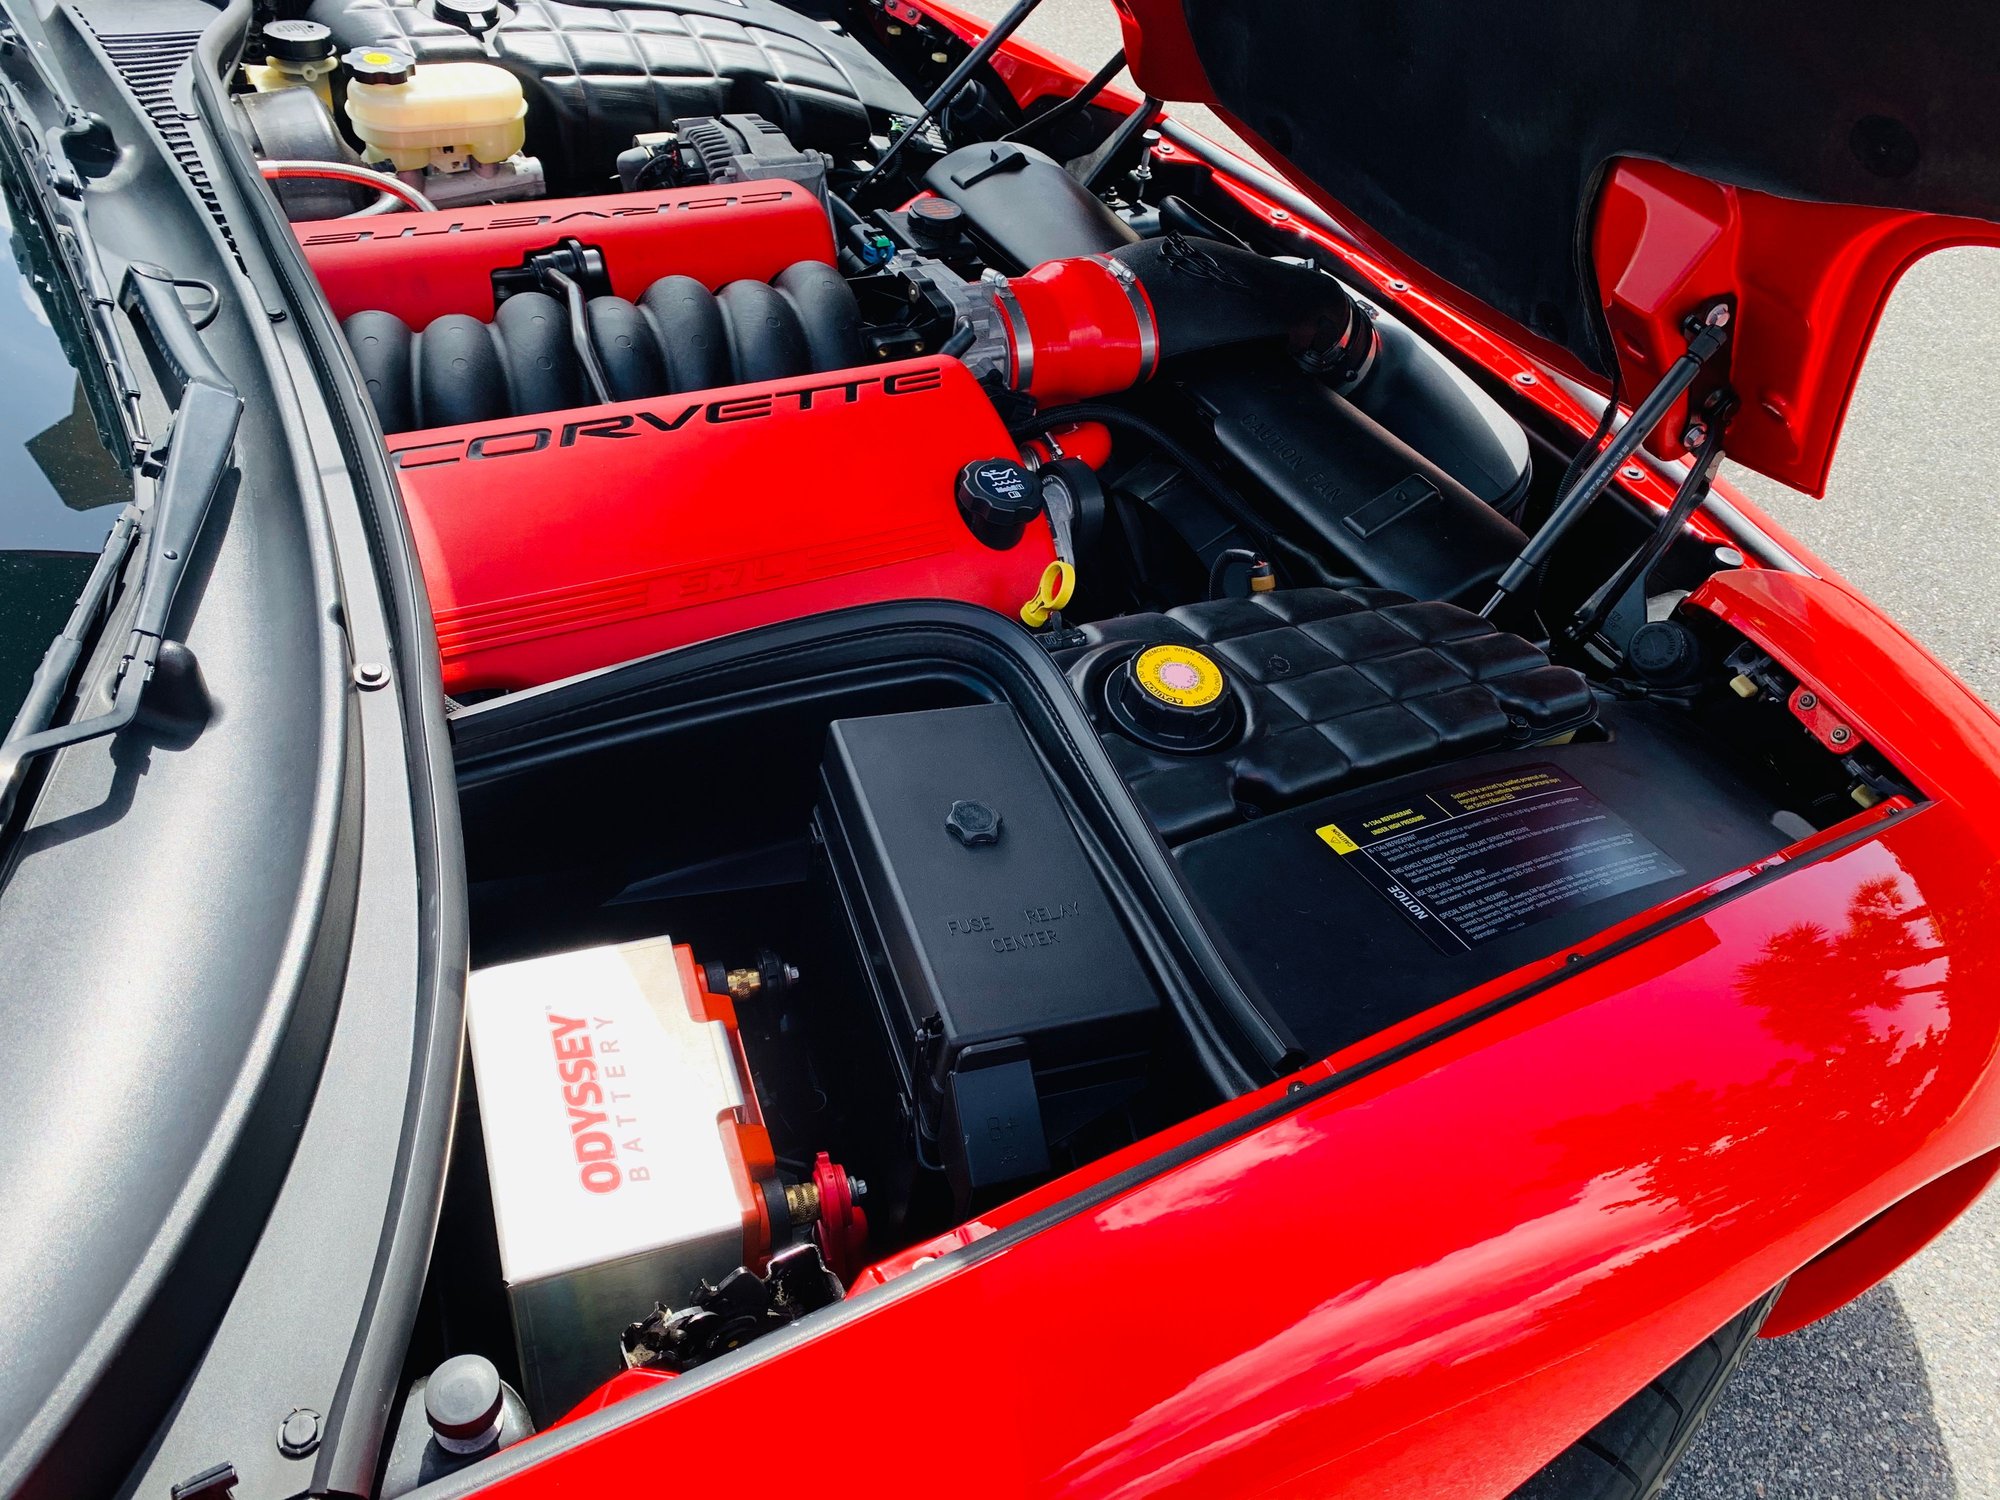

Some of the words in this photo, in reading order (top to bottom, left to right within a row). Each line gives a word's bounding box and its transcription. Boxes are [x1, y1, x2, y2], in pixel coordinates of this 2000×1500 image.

[303, 191, 792, 246] CORVETTE
[391, 366, 943, 471] CORVETTE
[1240, 413, 1303, 470] CAUTION
[1306, 471, 1342, 503] FAN
[1584, 445, 1629, 499] STABILUS
[680, 559, 785, 596] 5.7L
[1144, 681, 1174, 702] CAUTION
[1174, 647, 1195, 656] WHEN
[1370, 826, 1389, 835] UNDER
[1388, 822, 1401, 830] HIGH
[1400, 814, 1426, 825] PRESSURE
[1380, 808, 1413, 822] REFRIGERANT
[1331, 828, 1354, 848] CAUTION
[947, 916, 994, 936] FUSE
[1024, 901, 1080, 924] RELAY
[1387, 885, 1428, 921] NOTICE
[991, 930, 1060, 953] CENTER
[547, 1011, 624, 1195] ODYSSEY
[593, 1016, 651, 1182] BATTERY
